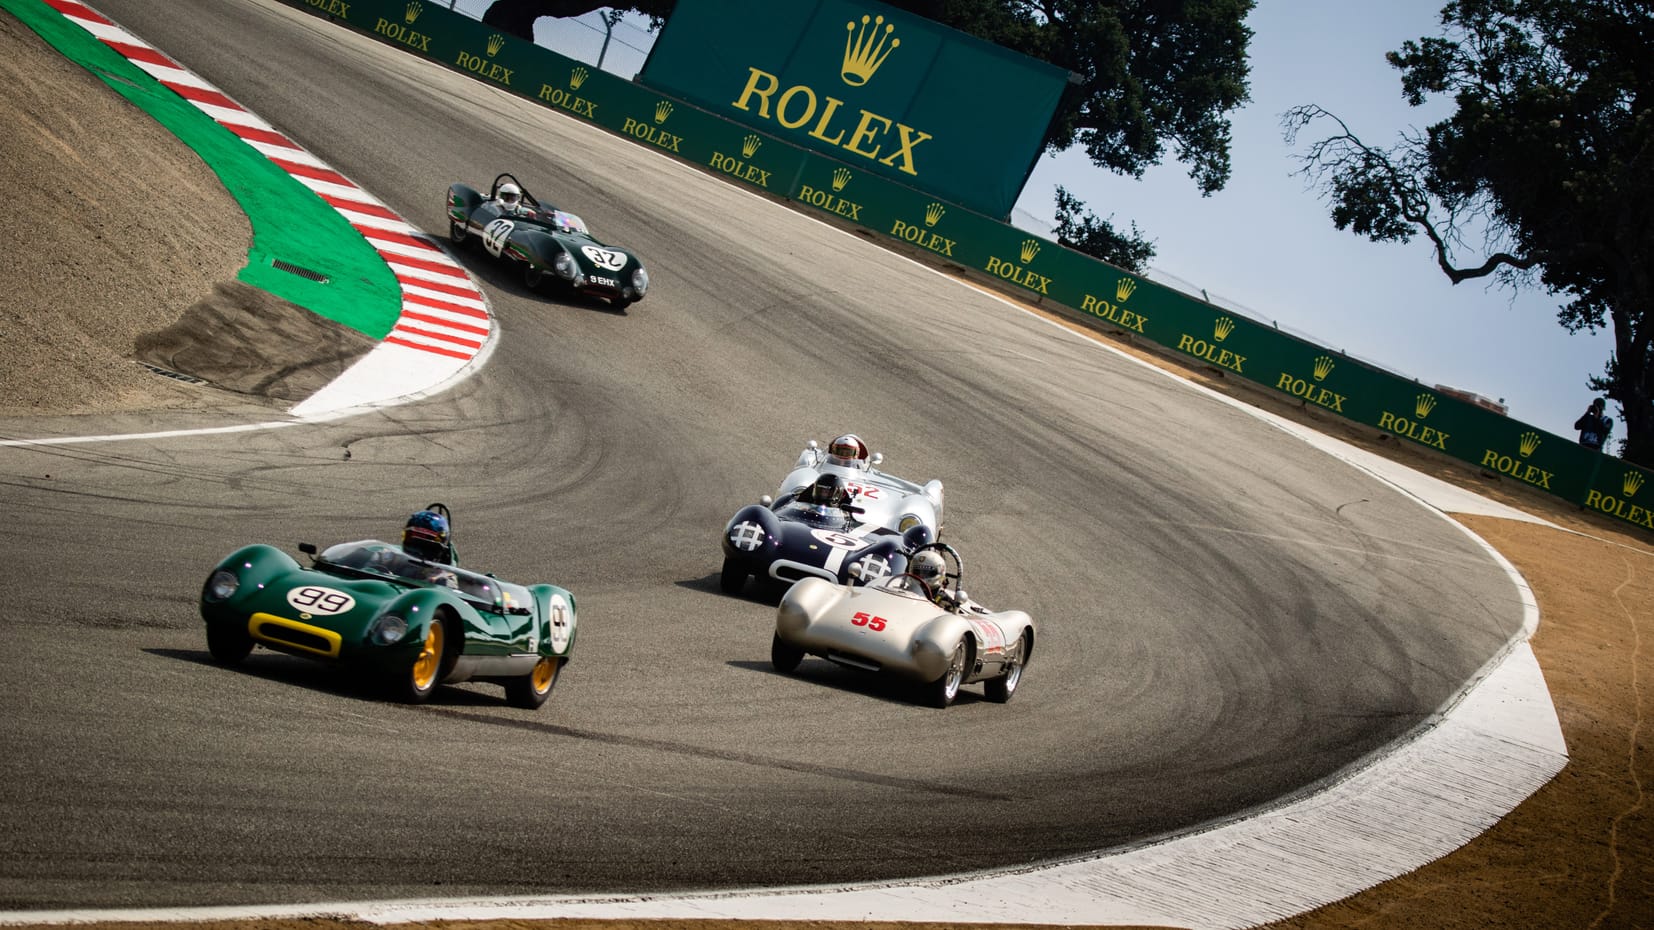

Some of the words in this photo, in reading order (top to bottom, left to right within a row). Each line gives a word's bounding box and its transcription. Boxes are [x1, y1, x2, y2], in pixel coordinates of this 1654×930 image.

[303, 0, 351, 19] LEX
[374, 17, 431, 51] ROLEX
[455, 52, 513, 85] ROLEX
[538, 85, 598, 118] ROLEX
[622, 118, 683, 152] ROLEX
[732, 67, 933, 176] ROLEX
[709, 151, 772, 187] ROLEX
[798, 185, 863, 222] ROLEX
[486, 220, 512, 251] 32
[890, 219, 956, 258] ROLEX
[588, 247, 621, 267] 32
[984, 255, 1052, 296] ROLEX
[1080, 294, 1149, 334] ROLEX
[1177, 334, 1247, 374] ROLEX
[1276, 372, 1347, 413] ROLEX
[1377, 411, 1450, 450] ROLEX
[1481, 449, 1554, 489] ROLEX
[1585, 489, 1654, 529] ROLEX
[825, 533, 857, 546] 5
[293, 588, 350, 612] 99
[851, 611, 887, 632] 55
